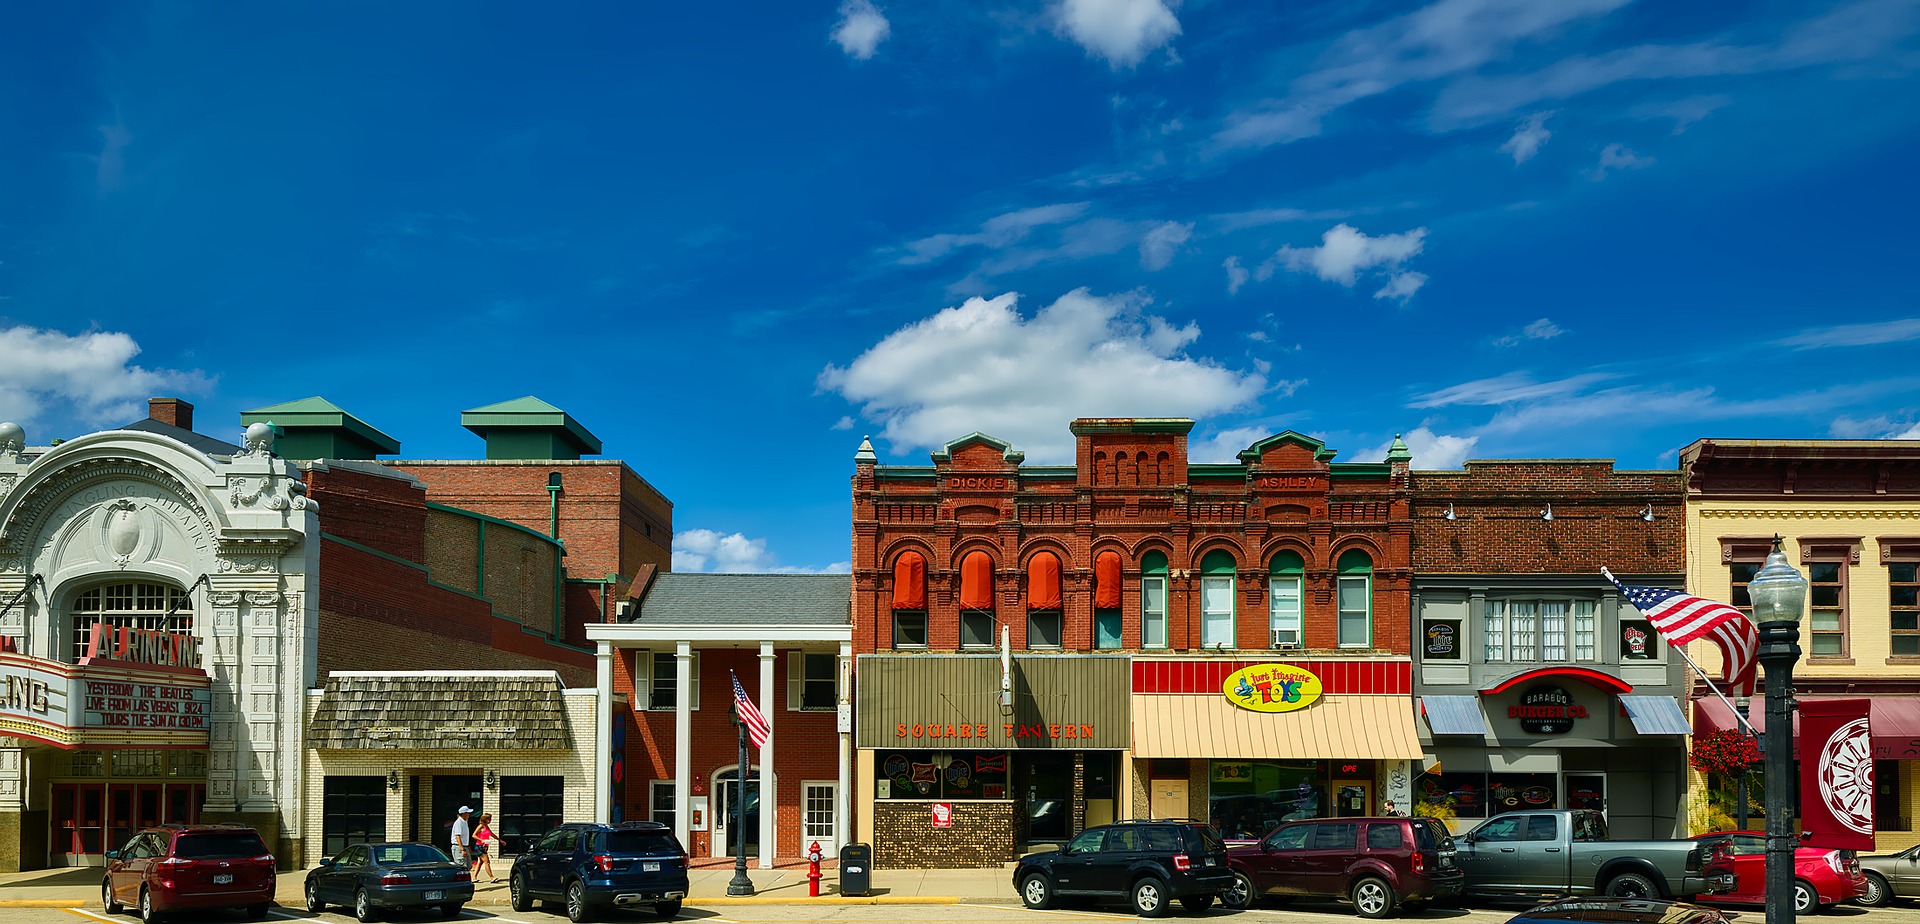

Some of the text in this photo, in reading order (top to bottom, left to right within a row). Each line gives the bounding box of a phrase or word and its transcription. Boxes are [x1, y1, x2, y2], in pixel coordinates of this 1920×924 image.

[951, 478, 1004, 488] DICKIE
[1261, 477, 1316, 488] ASHLEY
[128, 627, 204, 669] RINGLING
[1271, 668, 1311, 683] Imagine
[0, 675, 49, 712] ING
[87, 682, 193, 700] YESTERDAY THE BEATLES
[1256, 680, 1302, 704] TOYS
[87, 697, 105, 710] LIVE
[108, 698, 131, 711] FROM
[134, 699, 149, 712] LAS
[1527, 694, 1567, 704] BARABOO
[1508, 705, 1590, 718] BURGER CO.
[101, 713, 129, 726] TOURS
[131, 713, 167, 727] TUE-SUN
[168, 715, 178, 727] AT
[192, 716, 203, 728] PM
[896, 724, 1094, 739] SQUARE TAVERN
